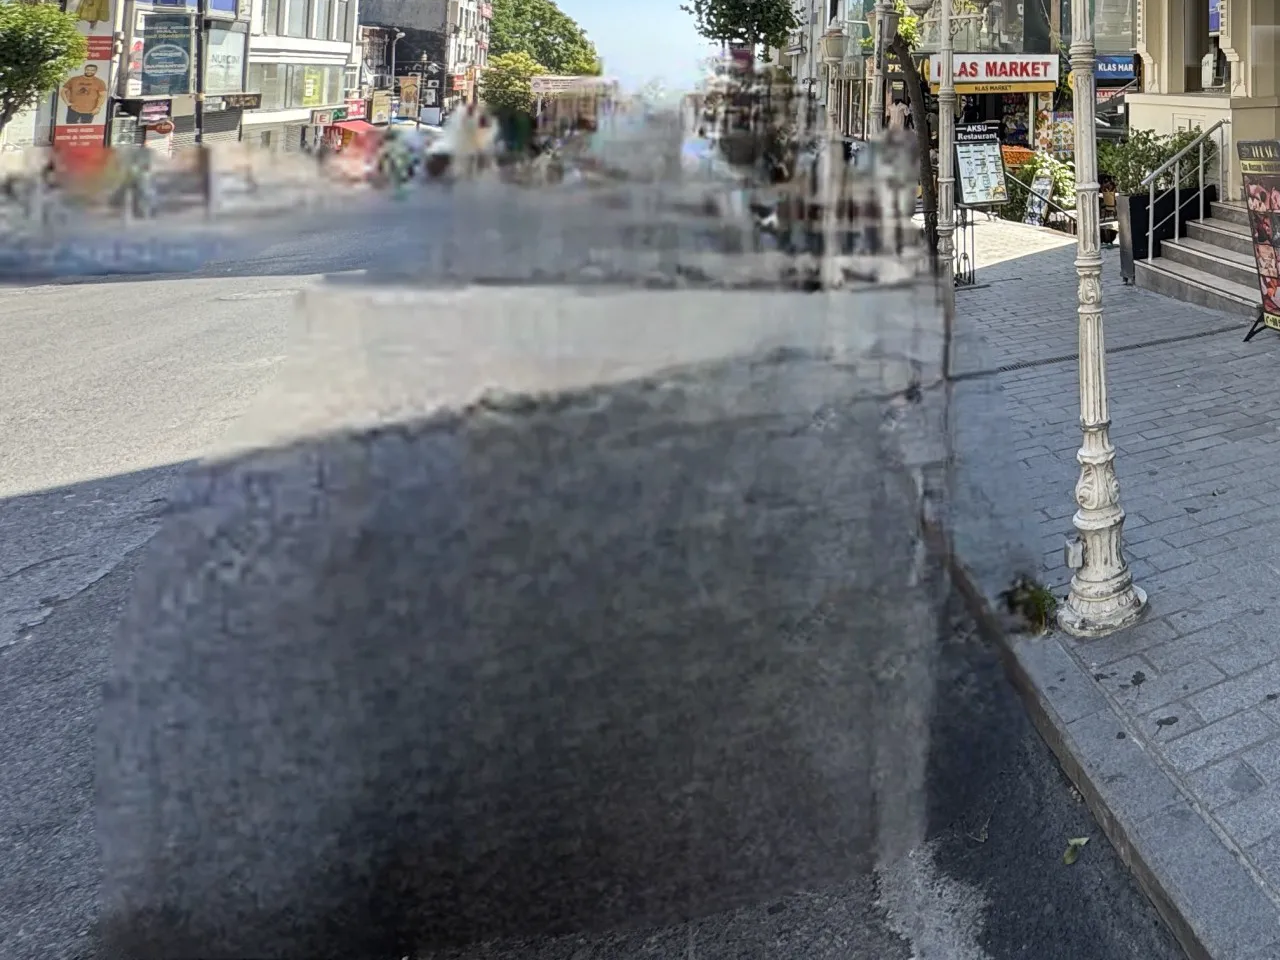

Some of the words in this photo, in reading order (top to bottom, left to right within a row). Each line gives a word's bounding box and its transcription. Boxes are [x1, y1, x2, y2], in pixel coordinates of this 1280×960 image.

[985, 61, 1051, 77] MARKET
[1098, 63, 1117, 72] KLAS
[957, 132, 998, 140] Restaurant
